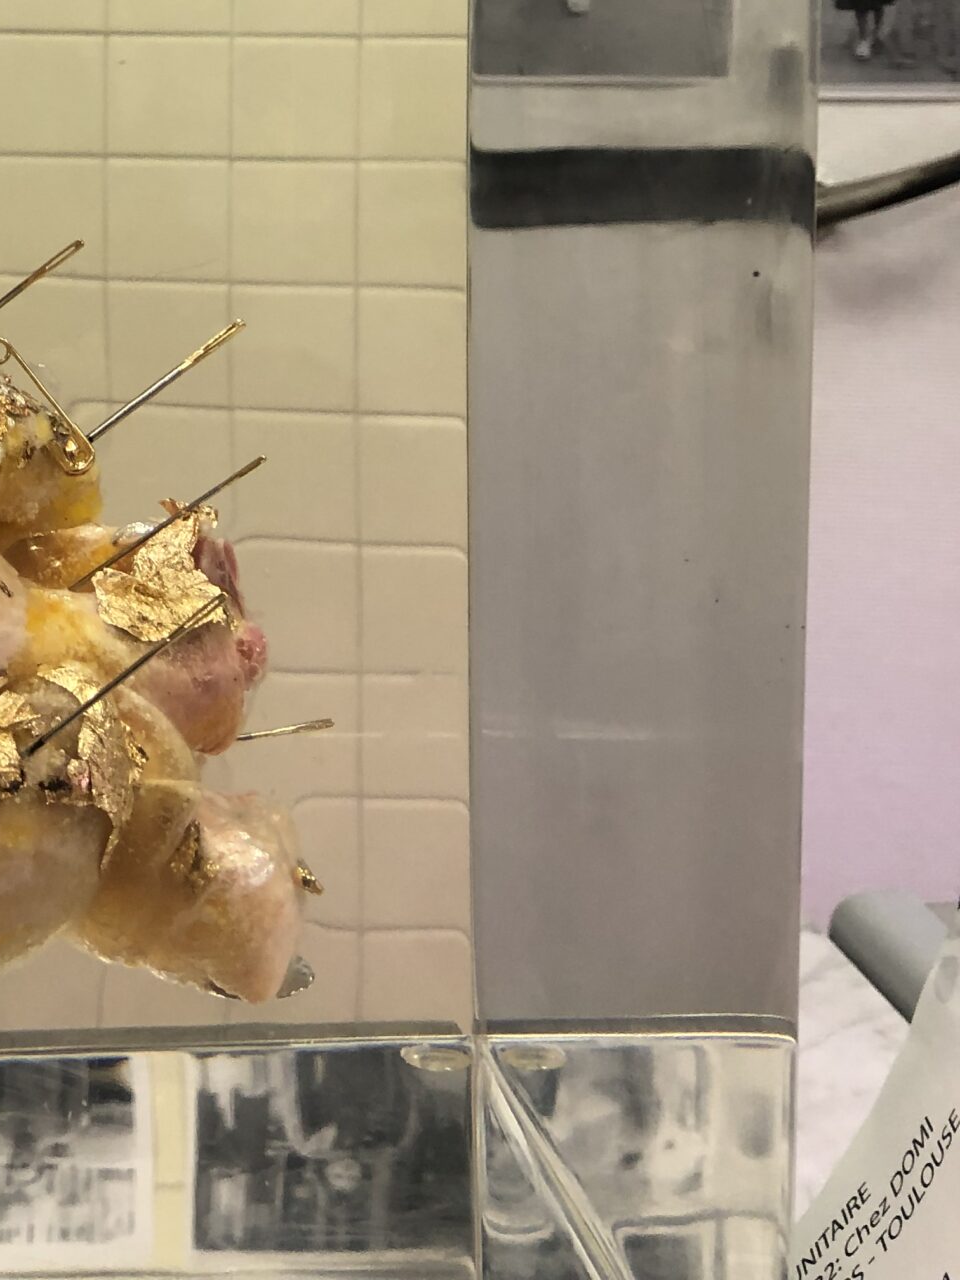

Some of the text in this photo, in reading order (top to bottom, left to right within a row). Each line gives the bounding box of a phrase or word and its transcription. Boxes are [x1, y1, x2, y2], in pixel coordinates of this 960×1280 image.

[844, 1196, 891, 1258] Chez
[889, 1116, 934, 1198] DOMI
[875, 1108, 960, 1252] TOULOUSE
